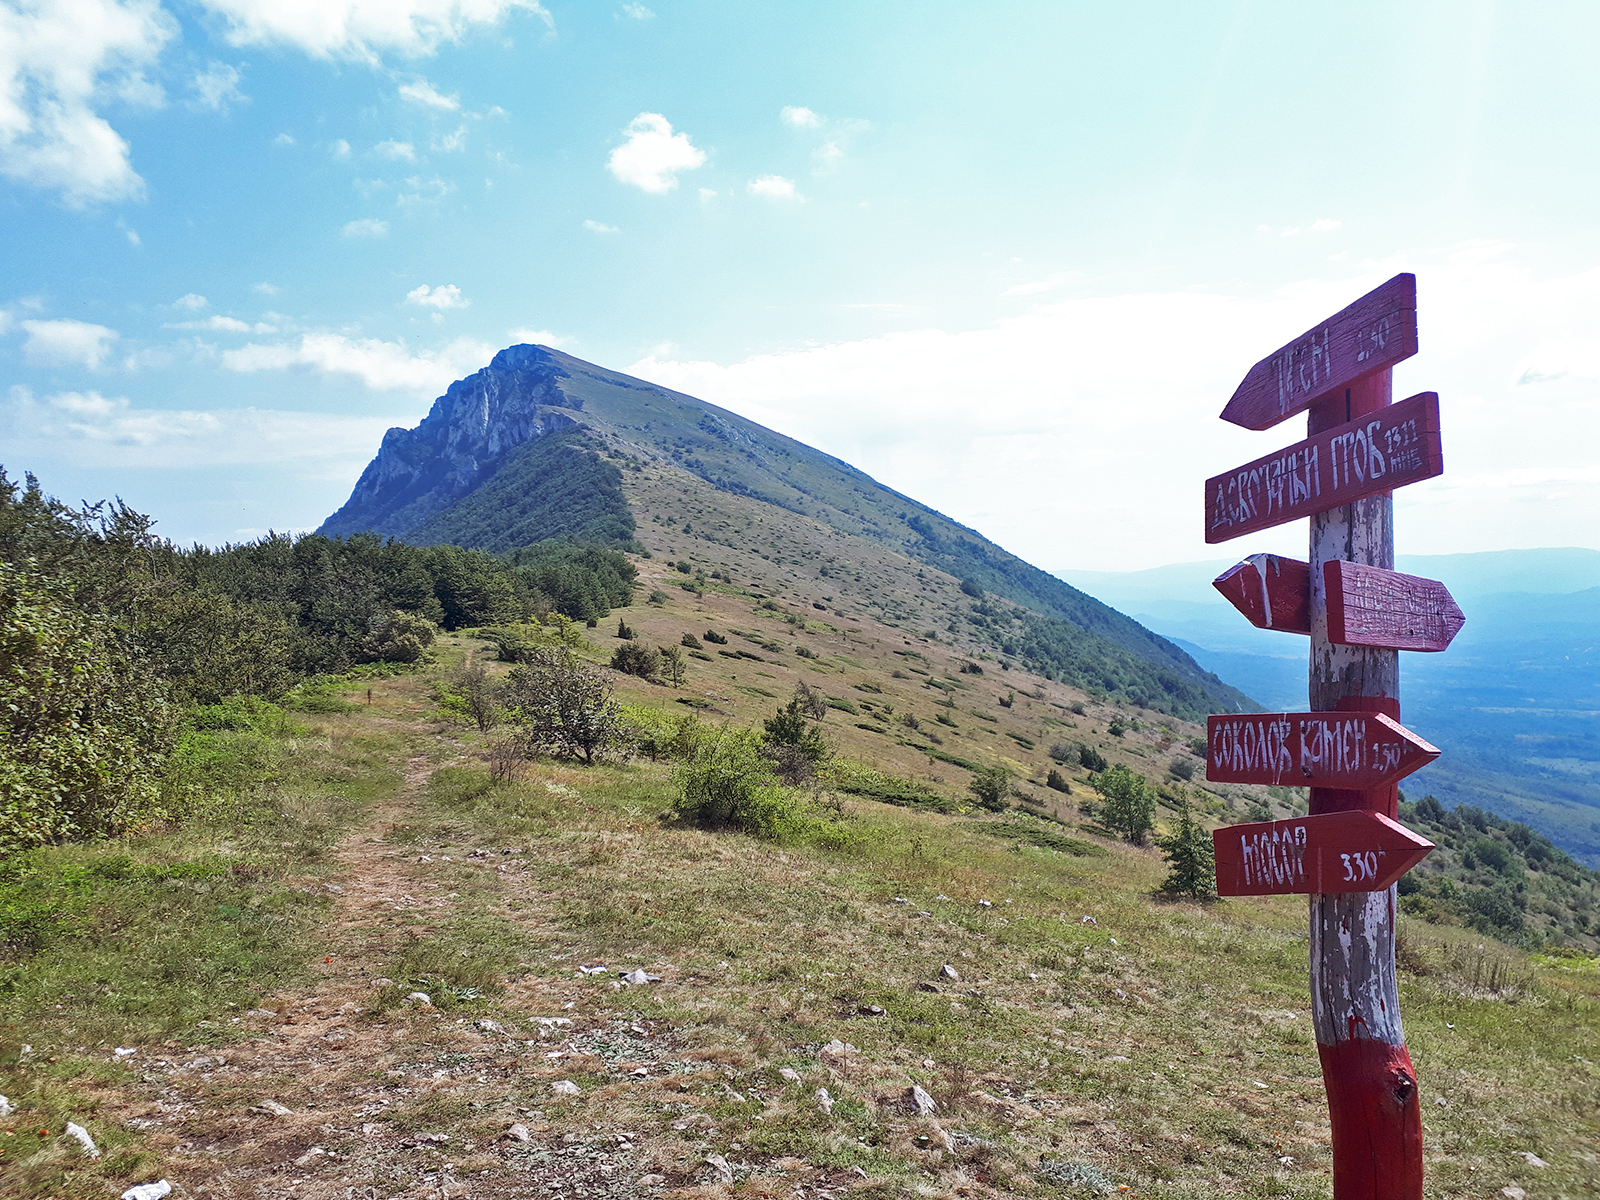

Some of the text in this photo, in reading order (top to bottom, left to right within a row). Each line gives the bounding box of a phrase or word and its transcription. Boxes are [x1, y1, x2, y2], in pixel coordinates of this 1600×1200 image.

[1331, 420, 1386, 489] ГРОБ
[1384, 418, 1419, 454] 1311
[1213, 721, 1292, 772] СОКОЛОВ
[1300, 719, 1367, 774] КАМЕН
